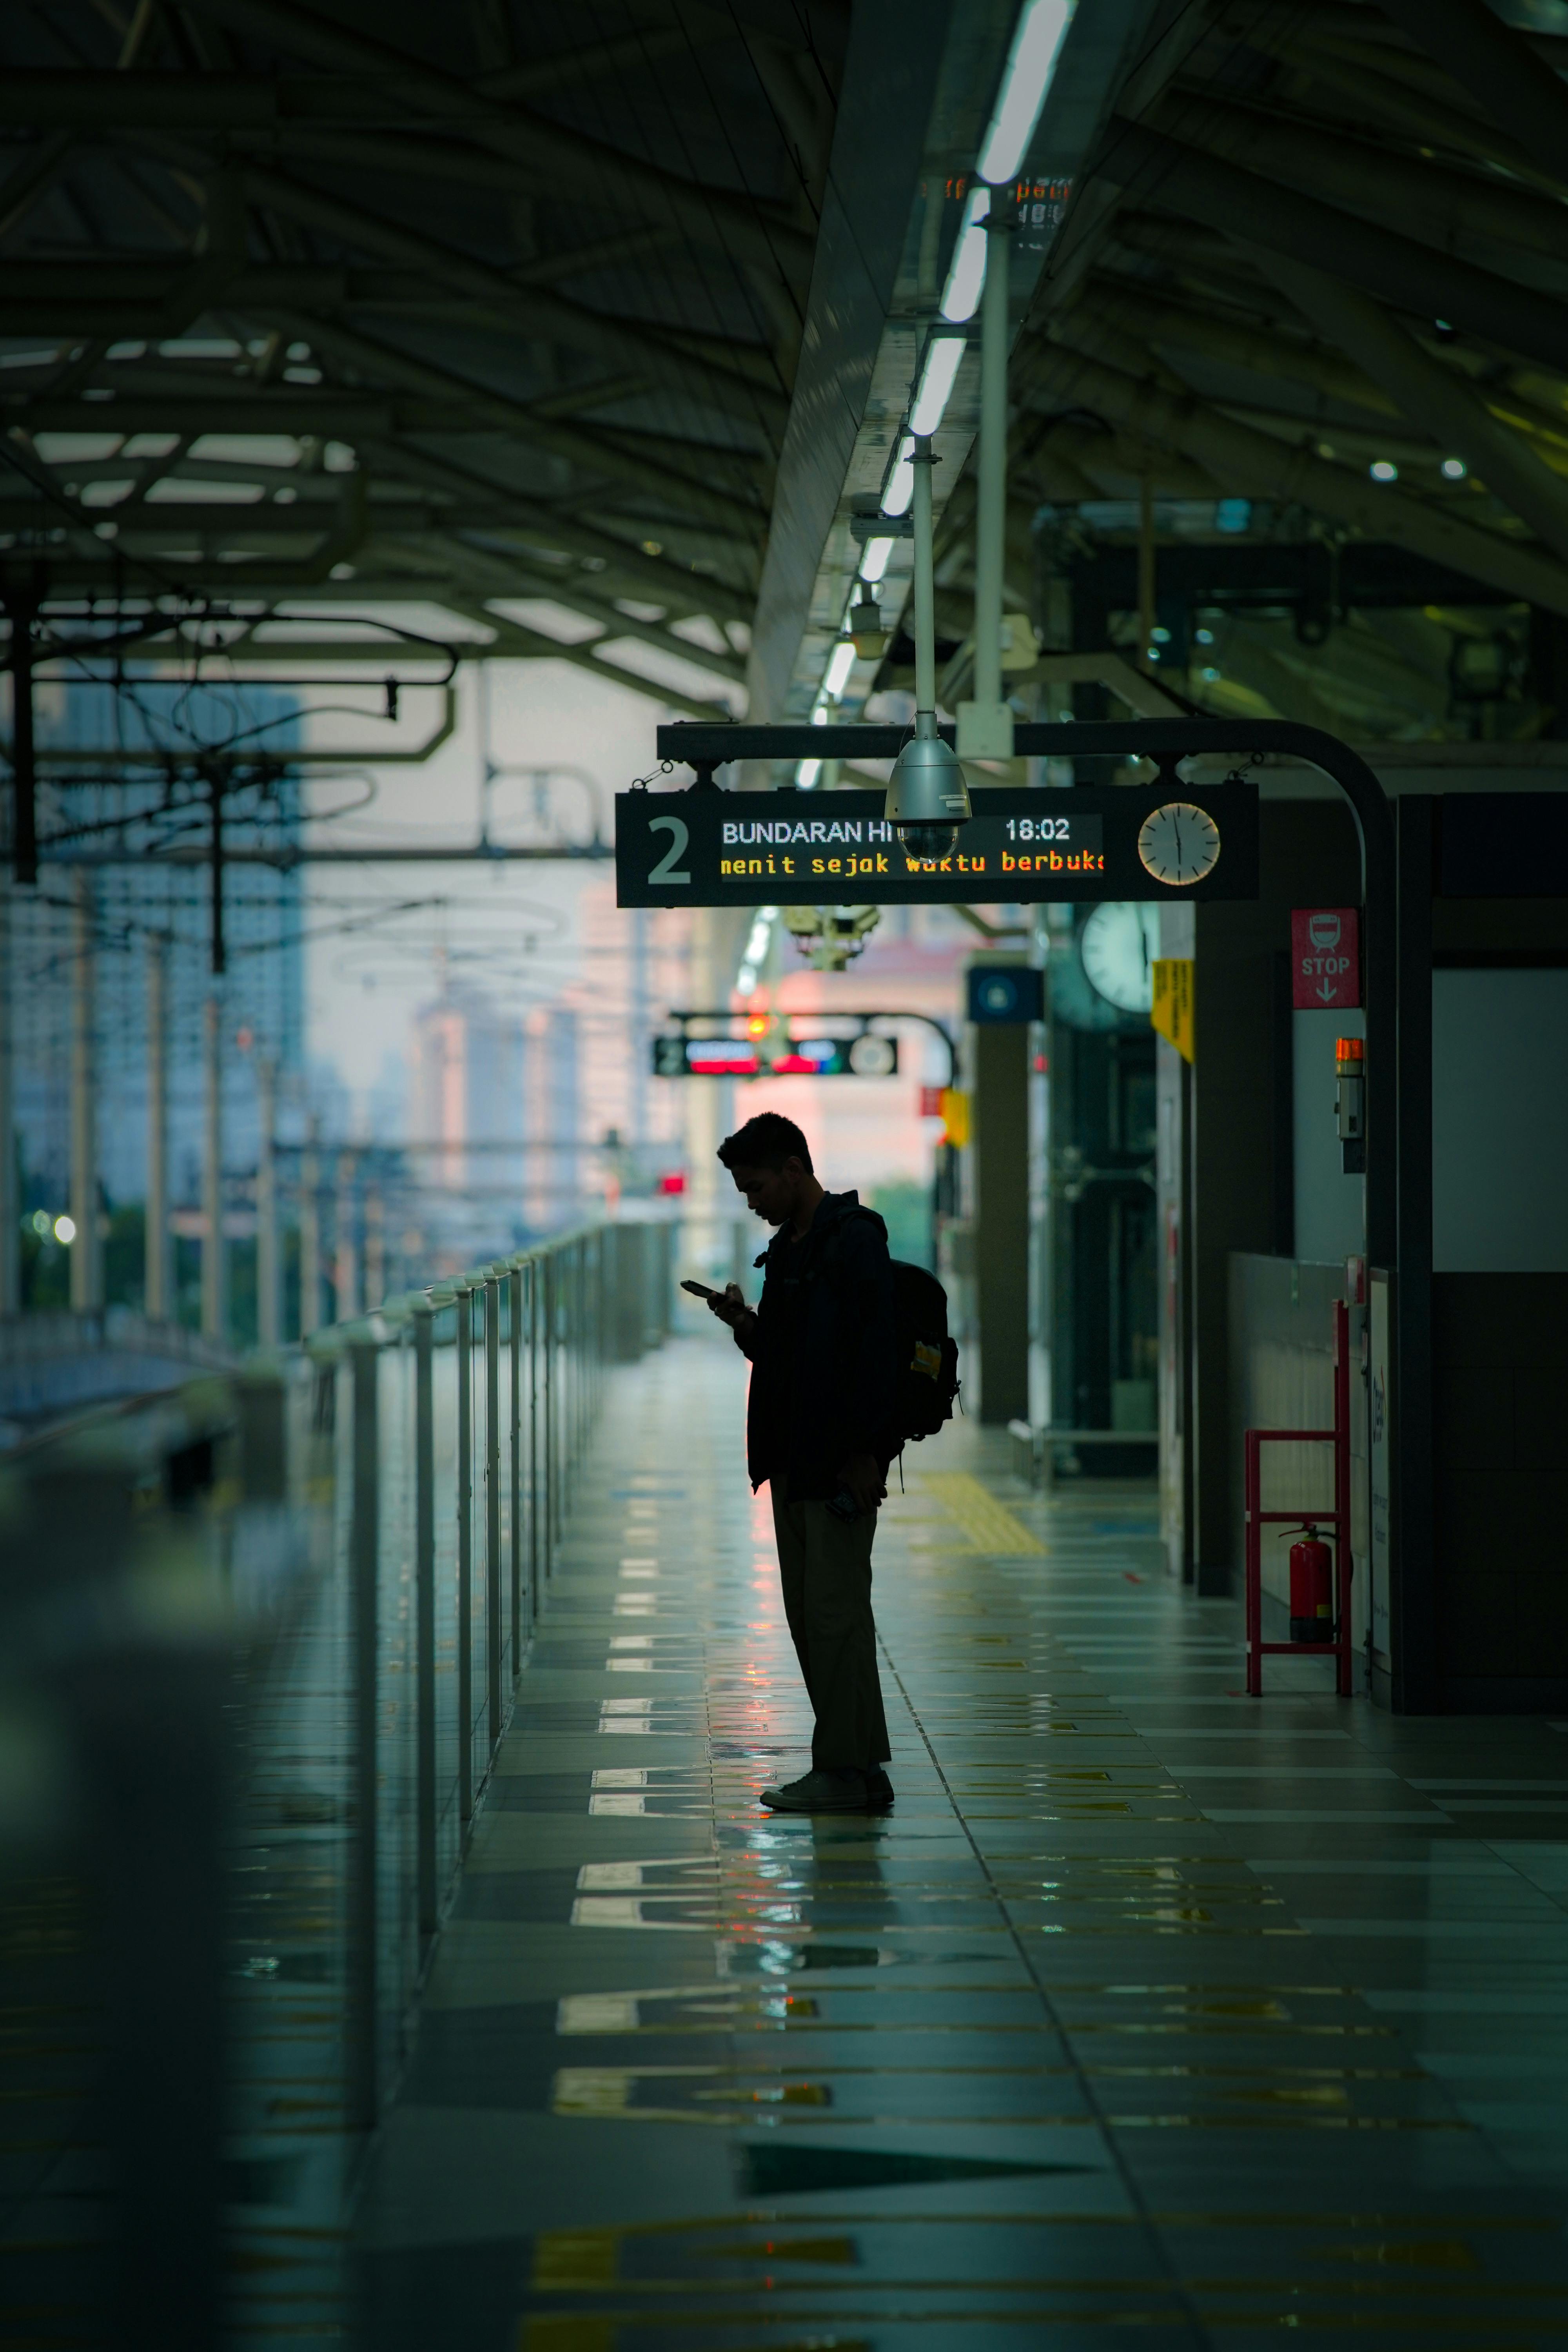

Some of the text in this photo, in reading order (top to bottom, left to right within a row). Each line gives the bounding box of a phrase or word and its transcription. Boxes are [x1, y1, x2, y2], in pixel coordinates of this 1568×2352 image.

[723, 821, 893, 844] BUNDARAN HI
[1006, 818, 1070, 841] 18:02
[648, 816, 691, 884] 2
[812, 853, 889, 877] sejak
[1301, 957, 1350, 975] STOP
